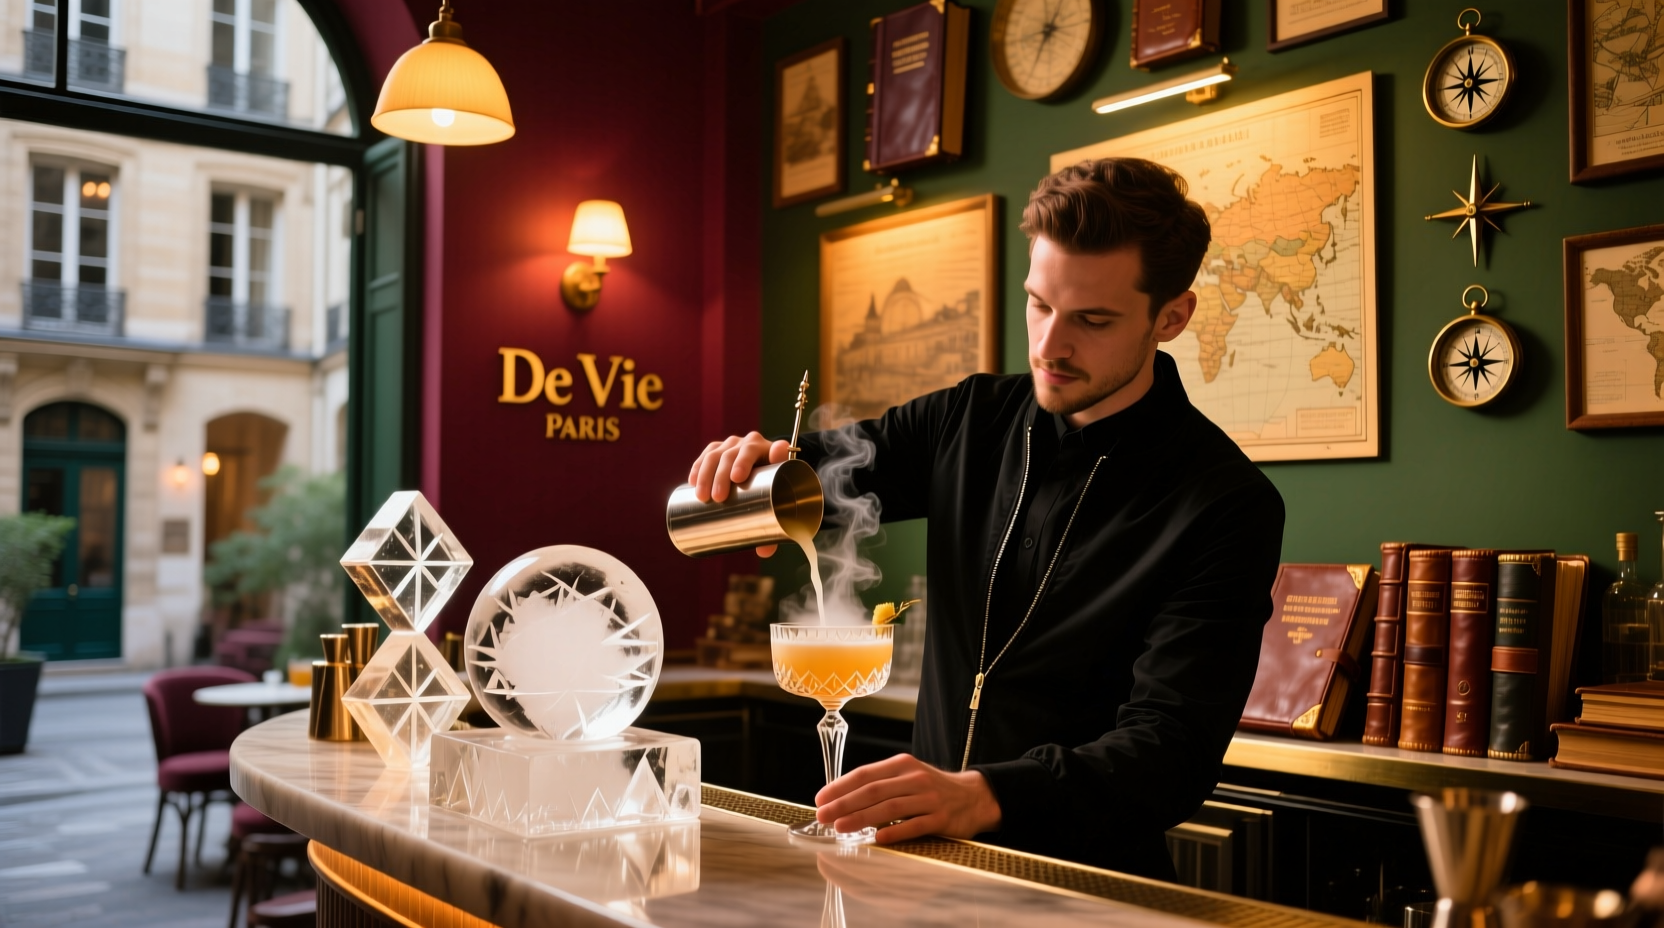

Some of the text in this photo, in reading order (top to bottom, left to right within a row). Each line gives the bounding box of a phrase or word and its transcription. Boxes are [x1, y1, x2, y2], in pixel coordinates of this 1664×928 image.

[498, 347, 664, 411] De Vie
[545, 413, 621, 442] PARIS
